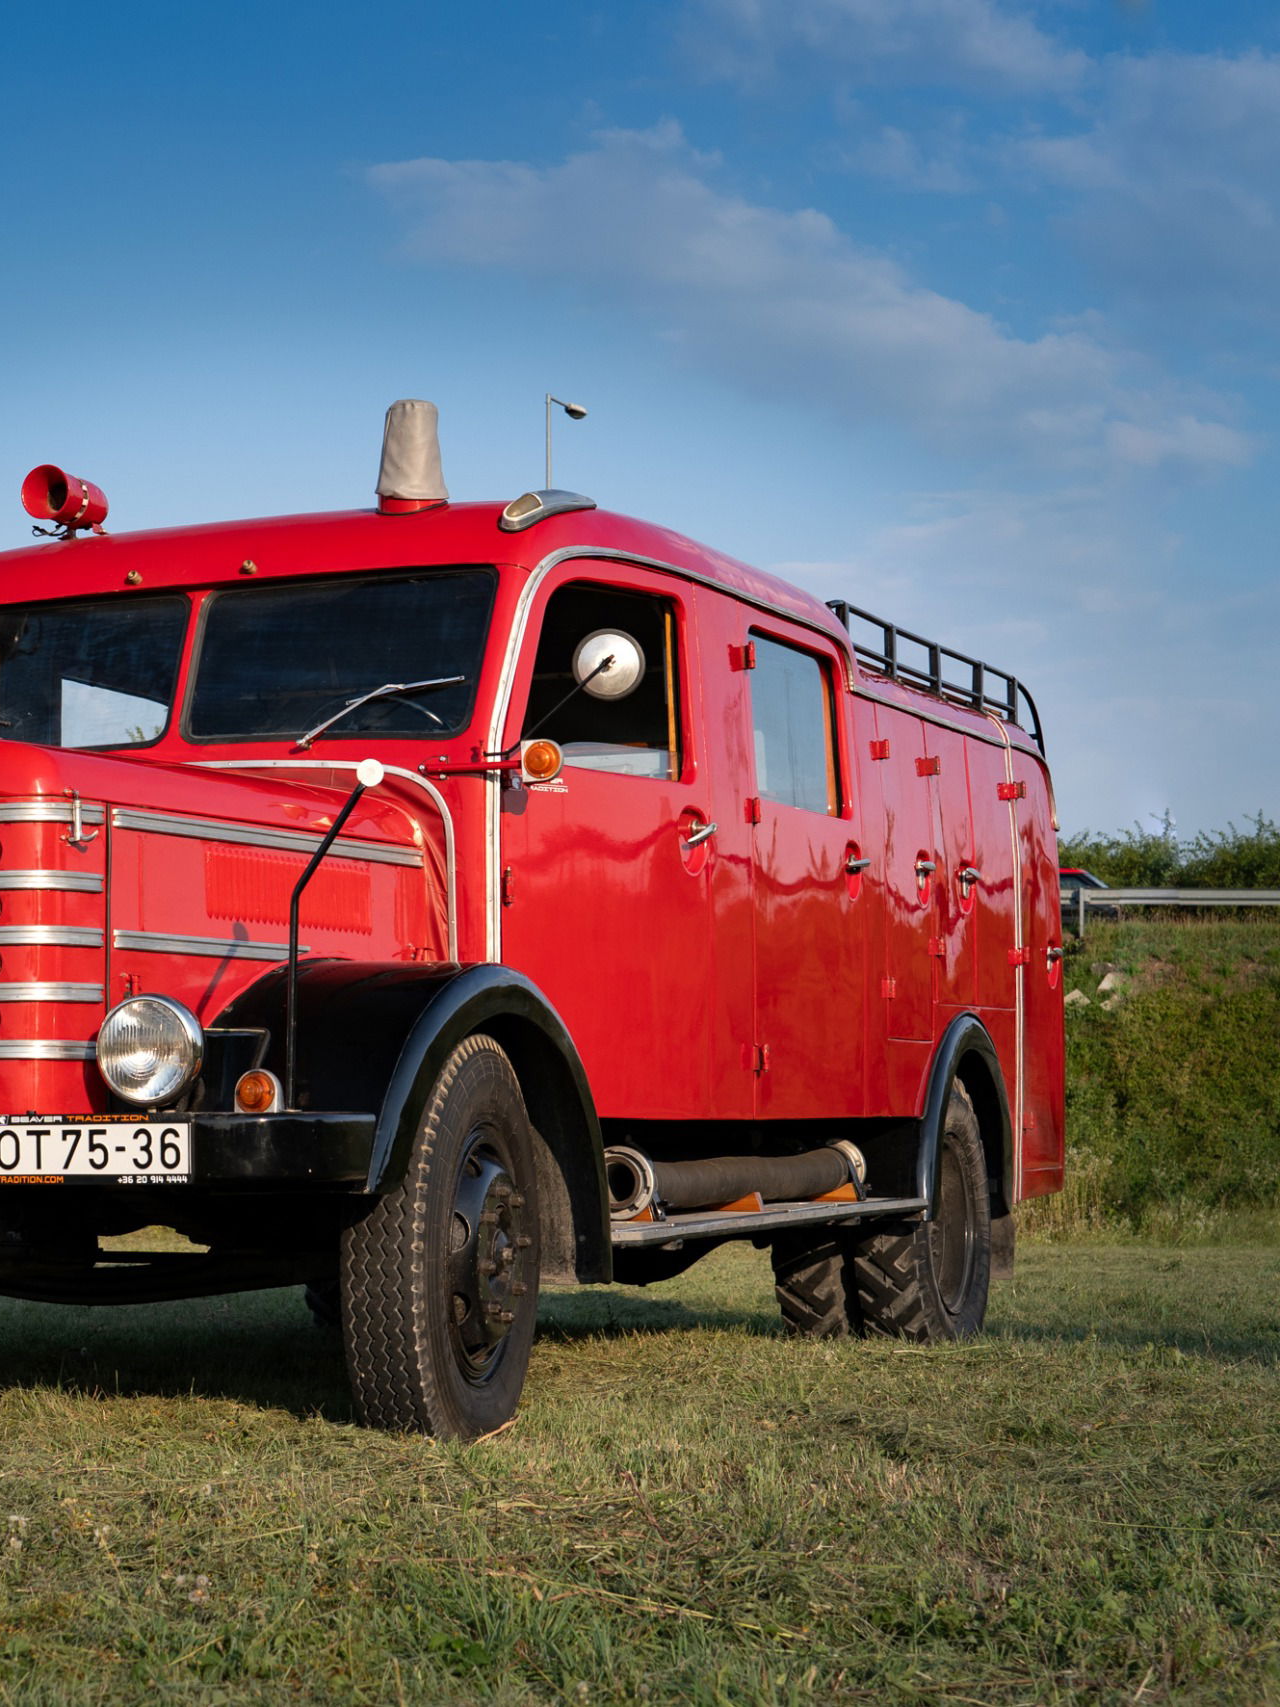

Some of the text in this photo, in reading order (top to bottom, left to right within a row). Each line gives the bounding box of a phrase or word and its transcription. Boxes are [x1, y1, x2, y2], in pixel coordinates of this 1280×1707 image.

[10, 1114, 149, 1123] BEAVER TRADITION
[117, 1175, 188, 1184] +36 20 914 4444
